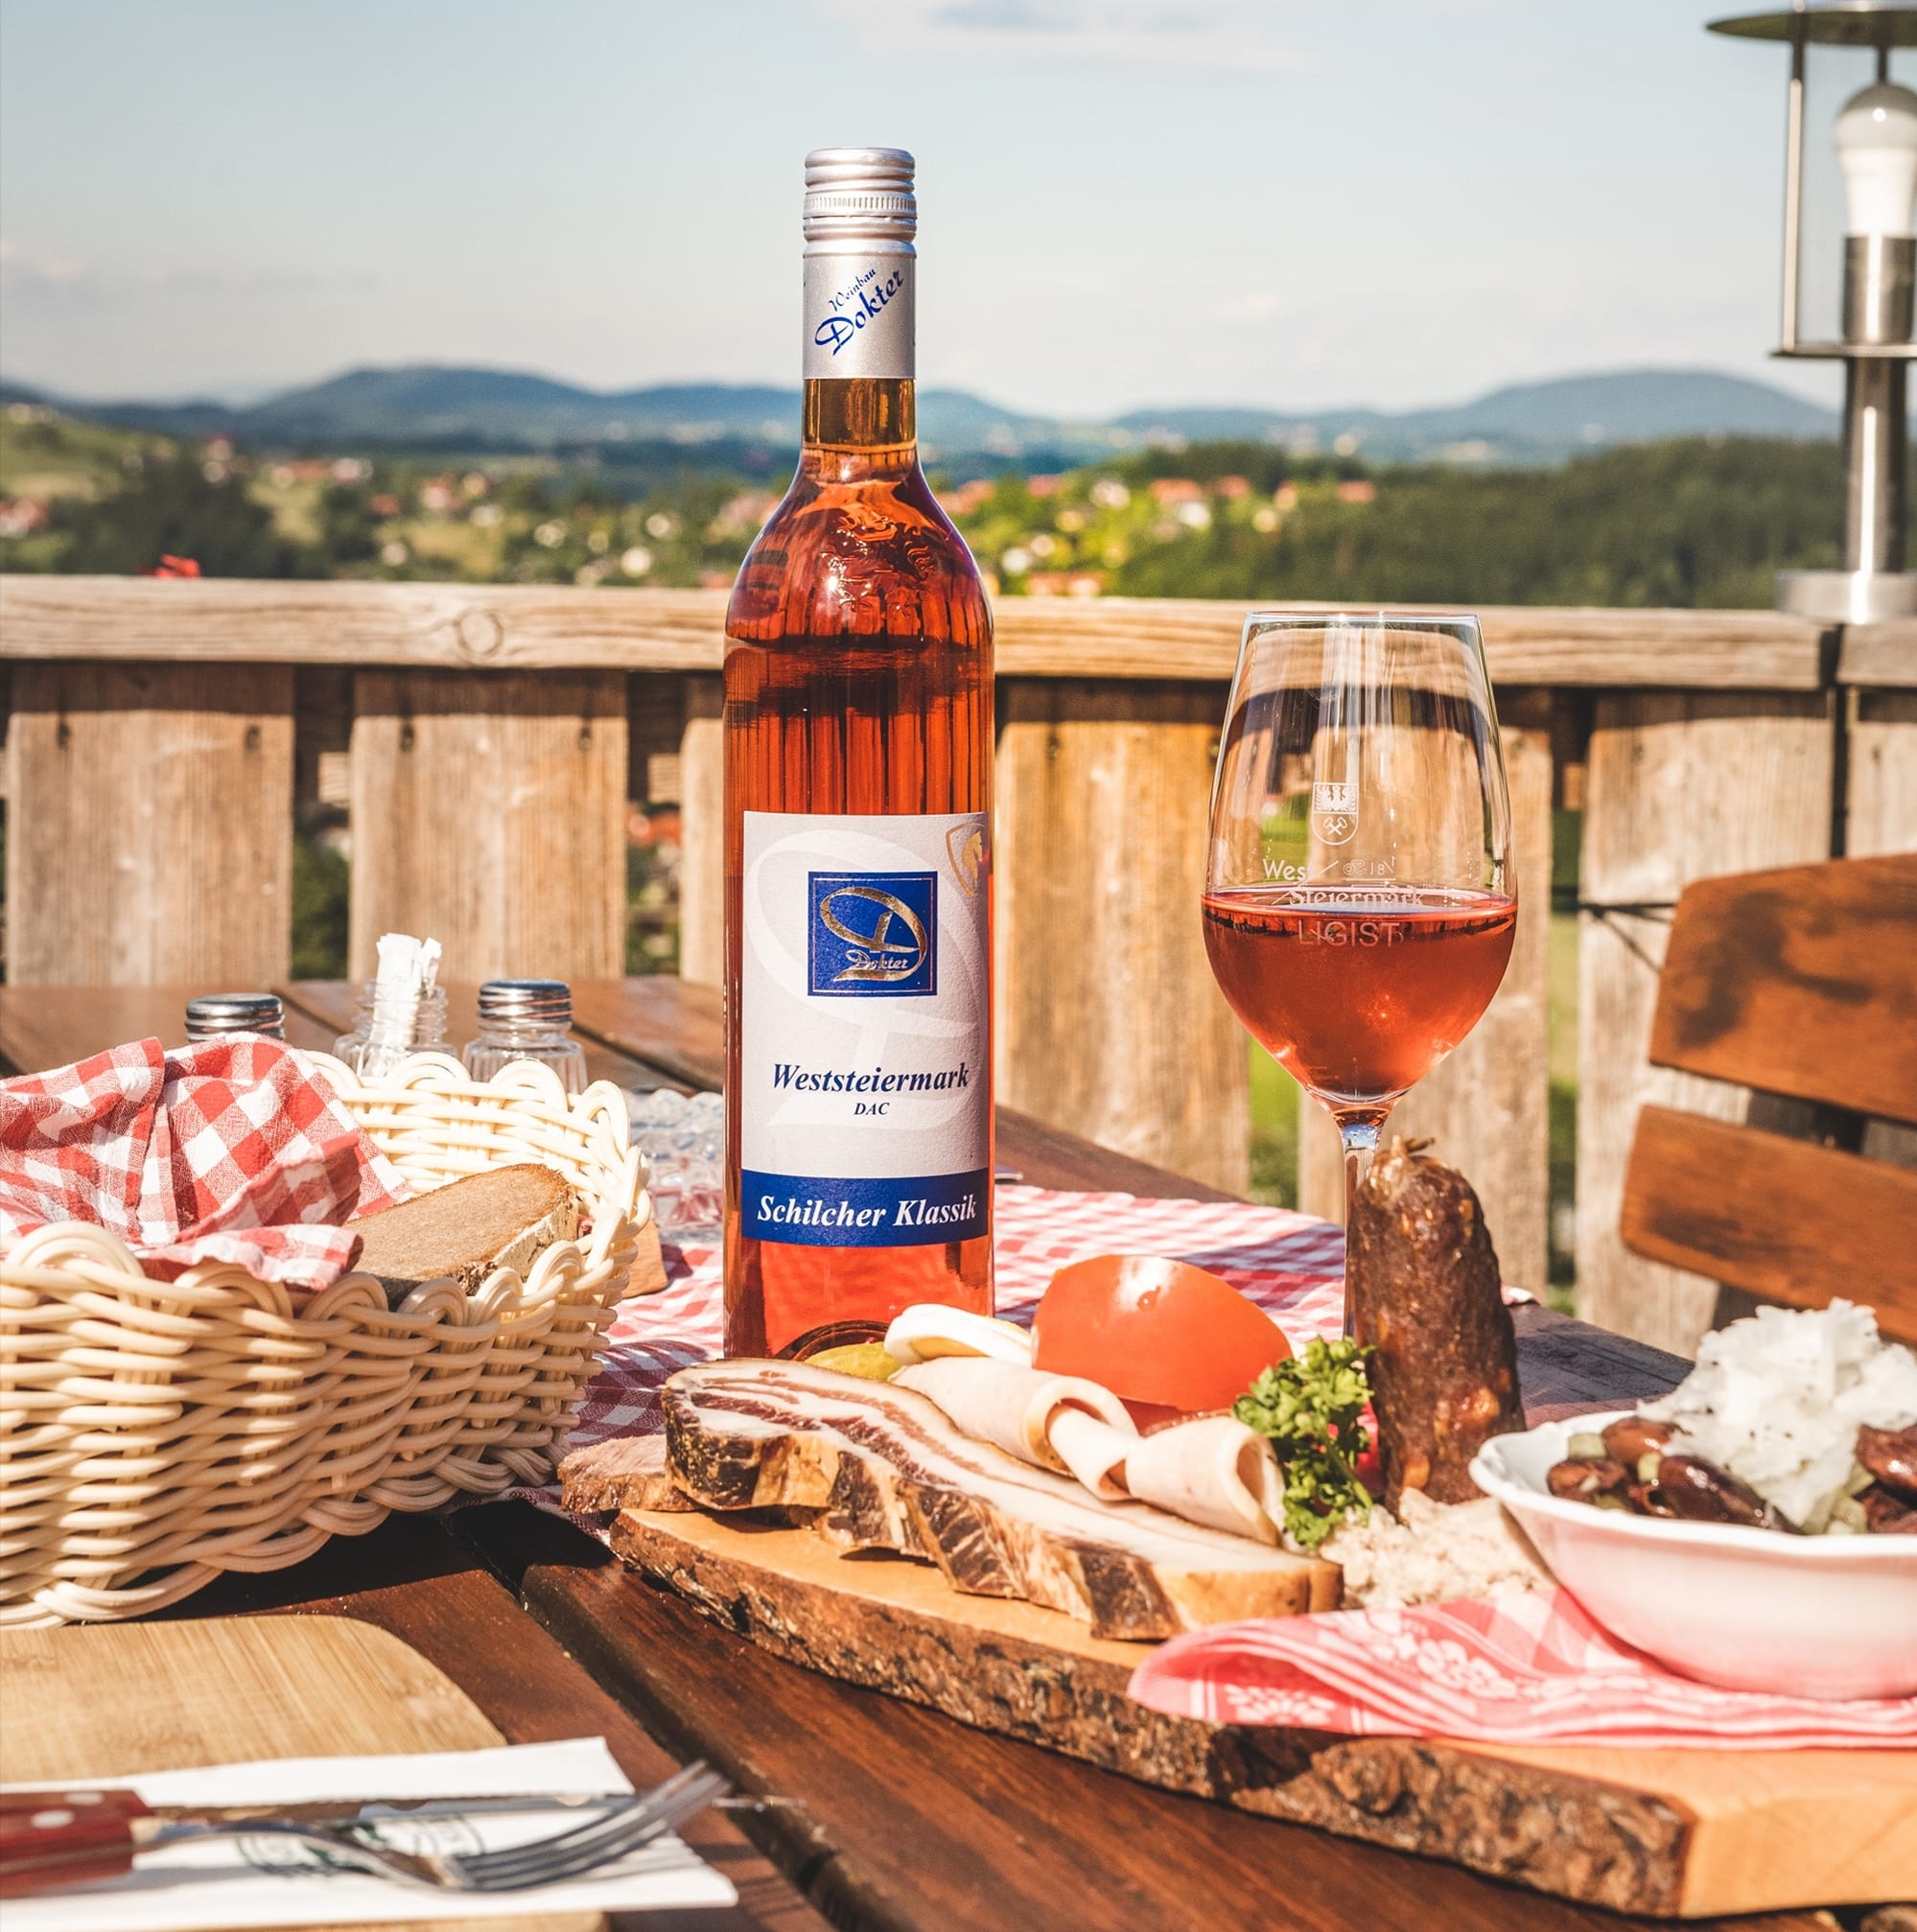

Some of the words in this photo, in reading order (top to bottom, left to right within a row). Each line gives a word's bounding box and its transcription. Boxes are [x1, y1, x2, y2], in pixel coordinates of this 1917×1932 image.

[829, 268, 877, 312] Weinbau
[814, 269, 903, 356] Dokter
[1263, 858, 1314, 881] Wes
[1297, 919, 1400, 947] LIGIST
[845, 949, 908, 970] Dokter
[773, 1061, 970, 1093] Weststeiermark
[853, 1102, 890, 1116] DAC
[758, 1195, 886, 1227] Schilcher
[893, 1194, 976, 1227] Klassik
